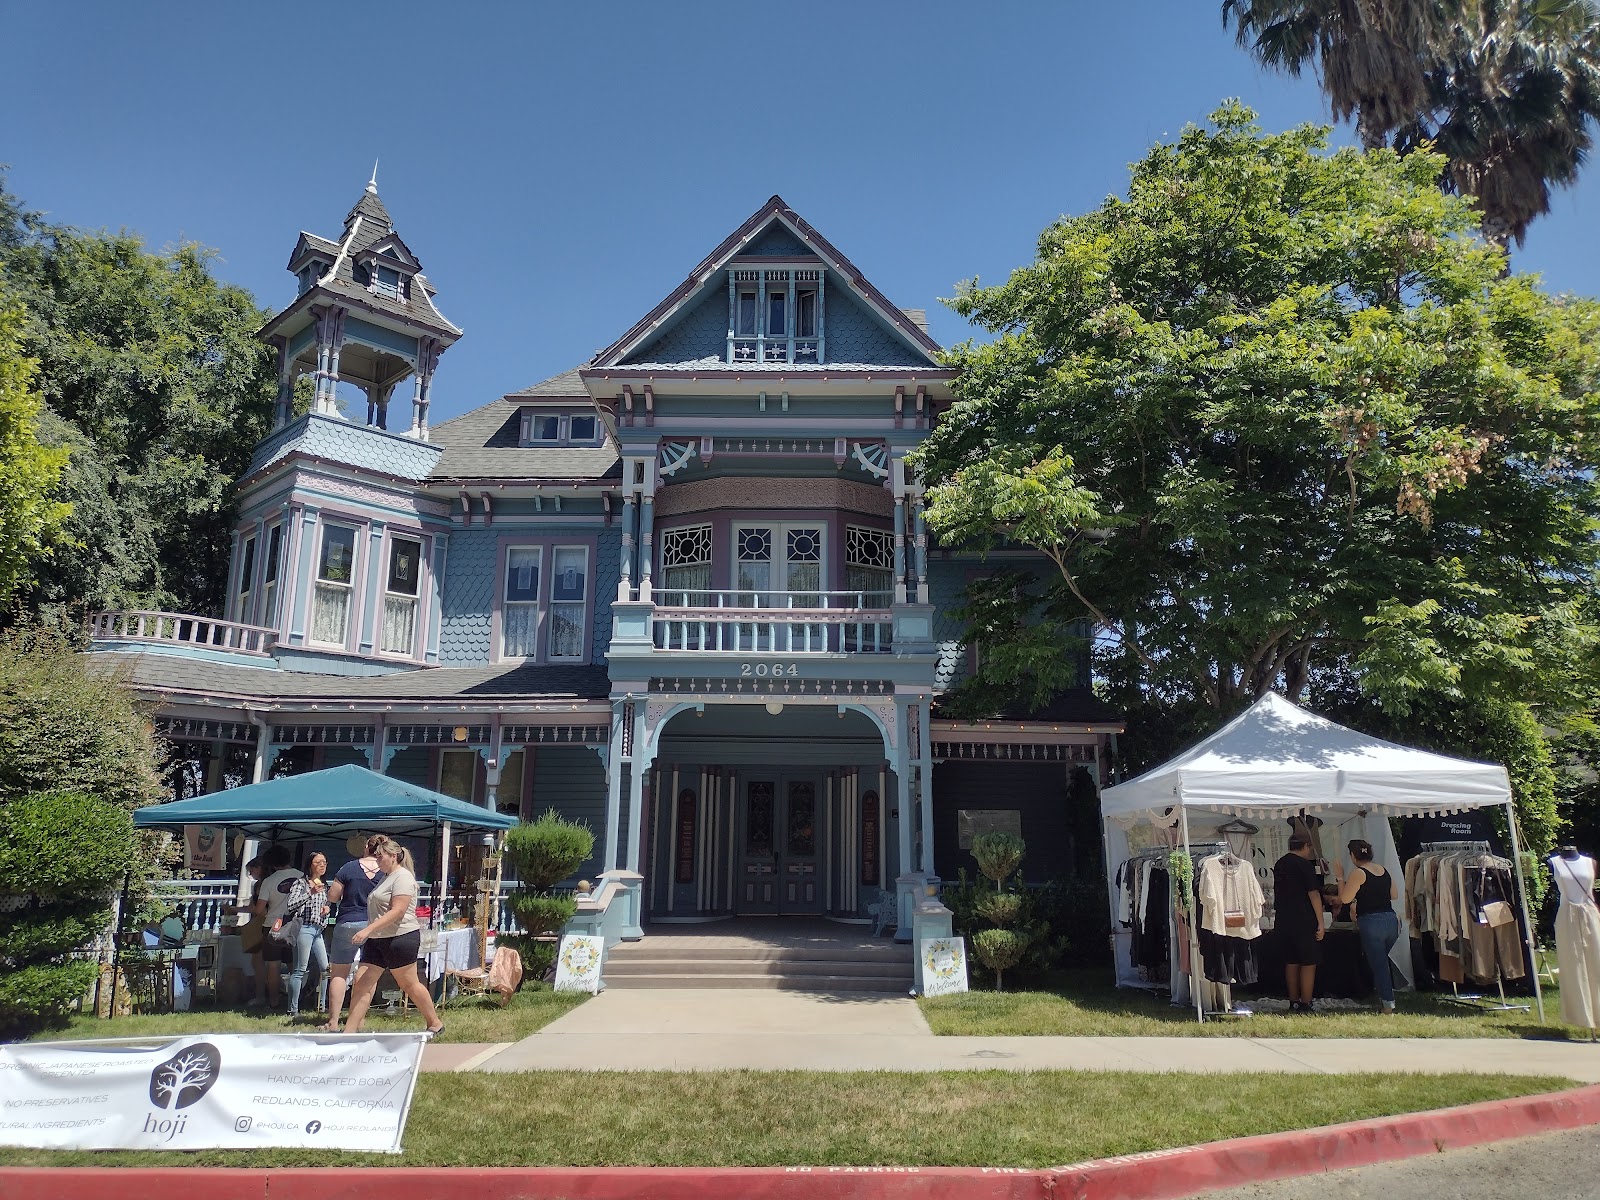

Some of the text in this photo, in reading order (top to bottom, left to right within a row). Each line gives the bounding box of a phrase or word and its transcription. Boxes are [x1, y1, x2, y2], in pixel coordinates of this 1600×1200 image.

[741, 663, 798, 677] 2064
[1441, 821, 1471, 829] Dressing
[272, 1053, 398, 1064] FRESH TEA & MILK TEA
[0, 1059, 154, 1071] ORGANIC JAPANESE ROASTED
[40, 1069, 75, 1080] GREEN
[267, 1074, 392, 1087] HANDCRAFTED BOBA
[4, 1094, 109, 1108] NO PRESERVATIVES
[252, 1095, 394, 1109] REDLANDS, CALIFORNIA
[33, 1118, 106, 1129] INGREDIENTS
[142, 1112, 188, 1142] hoji
[256, 1122, 299, 1130] @HOJI.CA
[323, 1124, 345, 1132] HOJI
[1051, 1160, 1100, 1173] LANE
